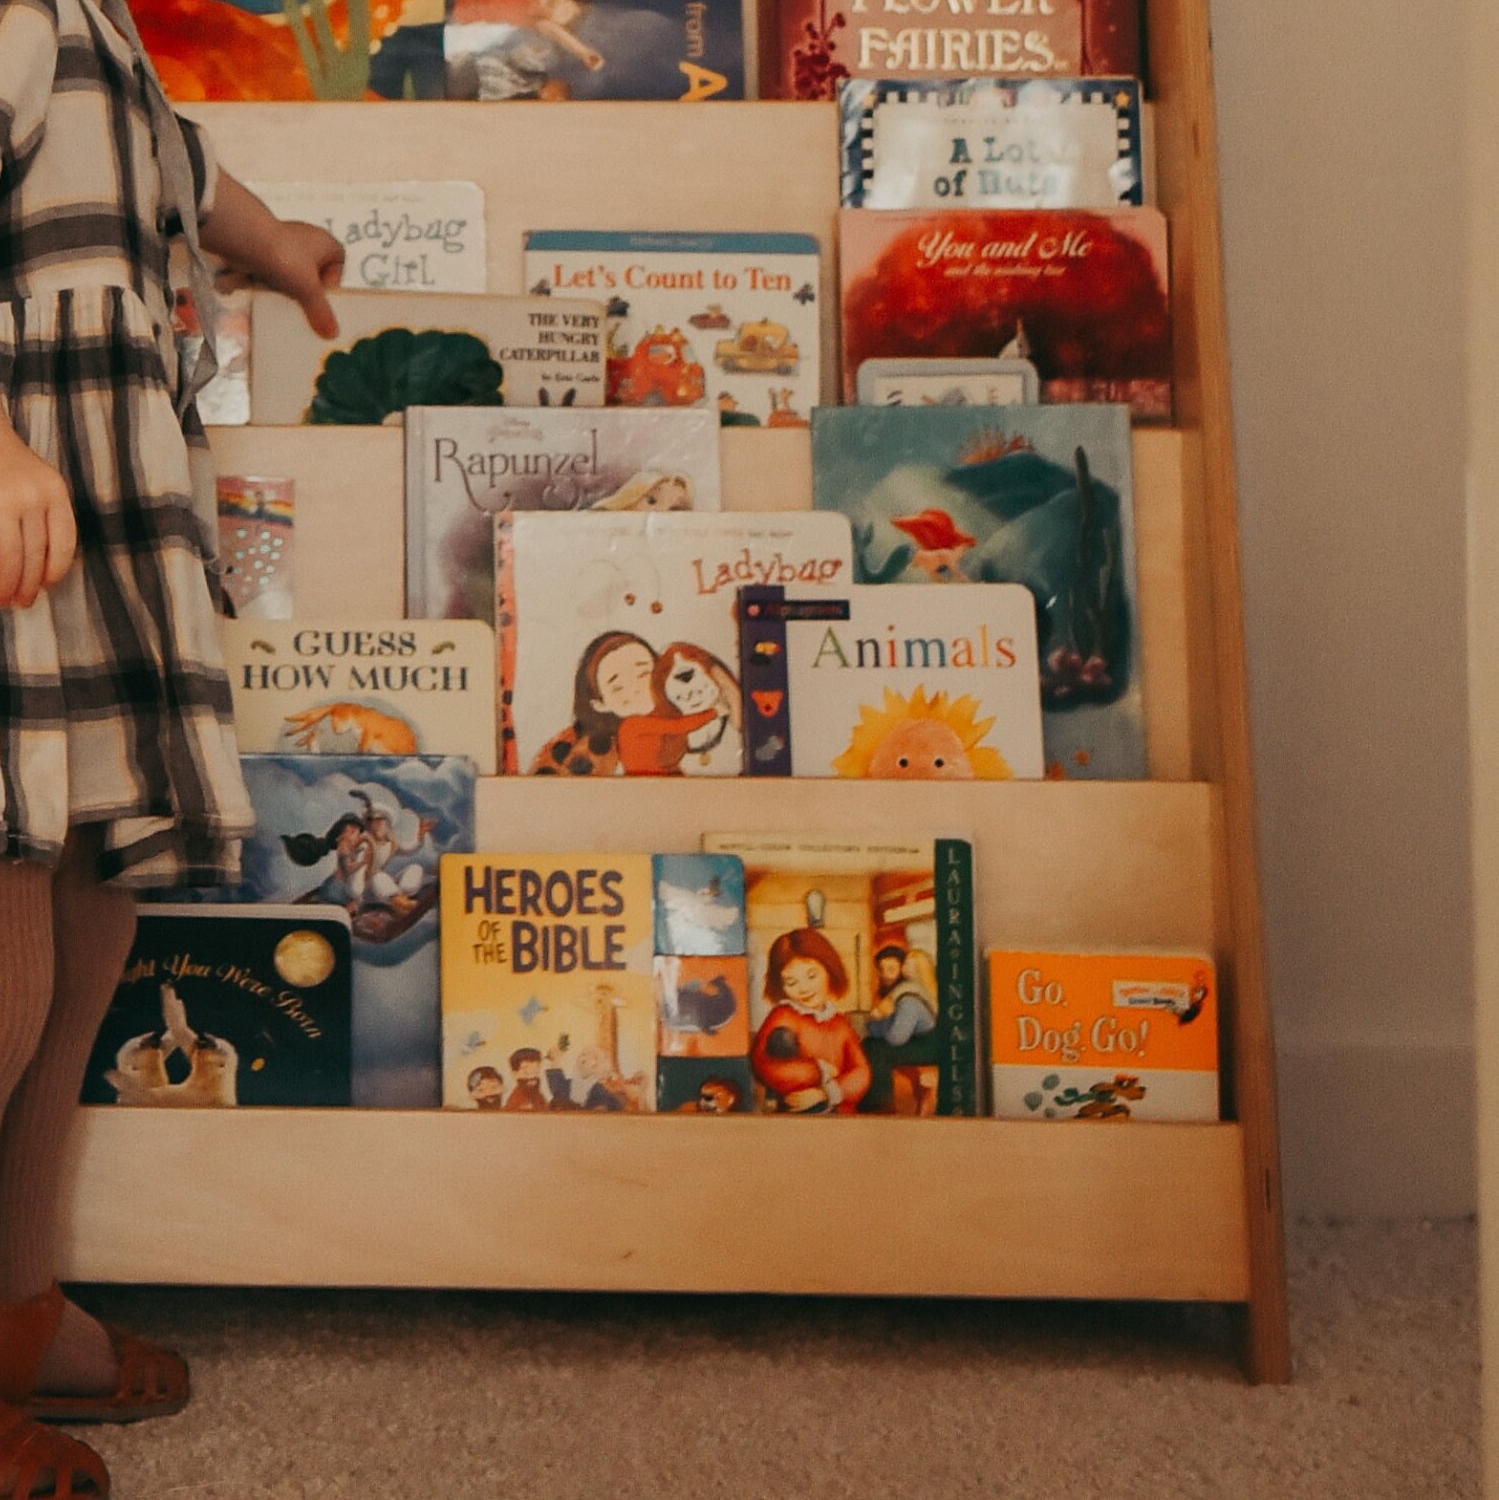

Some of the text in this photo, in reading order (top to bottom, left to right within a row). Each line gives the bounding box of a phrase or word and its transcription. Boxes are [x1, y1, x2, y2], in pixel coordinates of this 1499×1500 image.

[857, 27, 1055, 72] FAIRIES
[949, 136, 1041, 164] A Lot
[933, 170, 967, 197] of
[916, 230, 1093, 268] You and Me
[553, 264, 792, 291] Let's Count to Ten
[528, 313, 600, 329] THE VERY
[538, 331, 599, 346] HUNGRY
[499, 349, 600, 363] CATERPILLAR
[433, 428, 598, 511] Rapunzel
[293, 630, 417, 657] GUESS
[812, 624, 1017, 670] Animals
[240, 664, 469, 692] HOW MUCH
[464, 865, 624, 917] HEROES
[478, 920, 501, 941] OF
[472, 920, 627, 974] THE BIBLE
[162, 953, 211, 980] You
[1091, 1016, 1149, 1058] Go!
